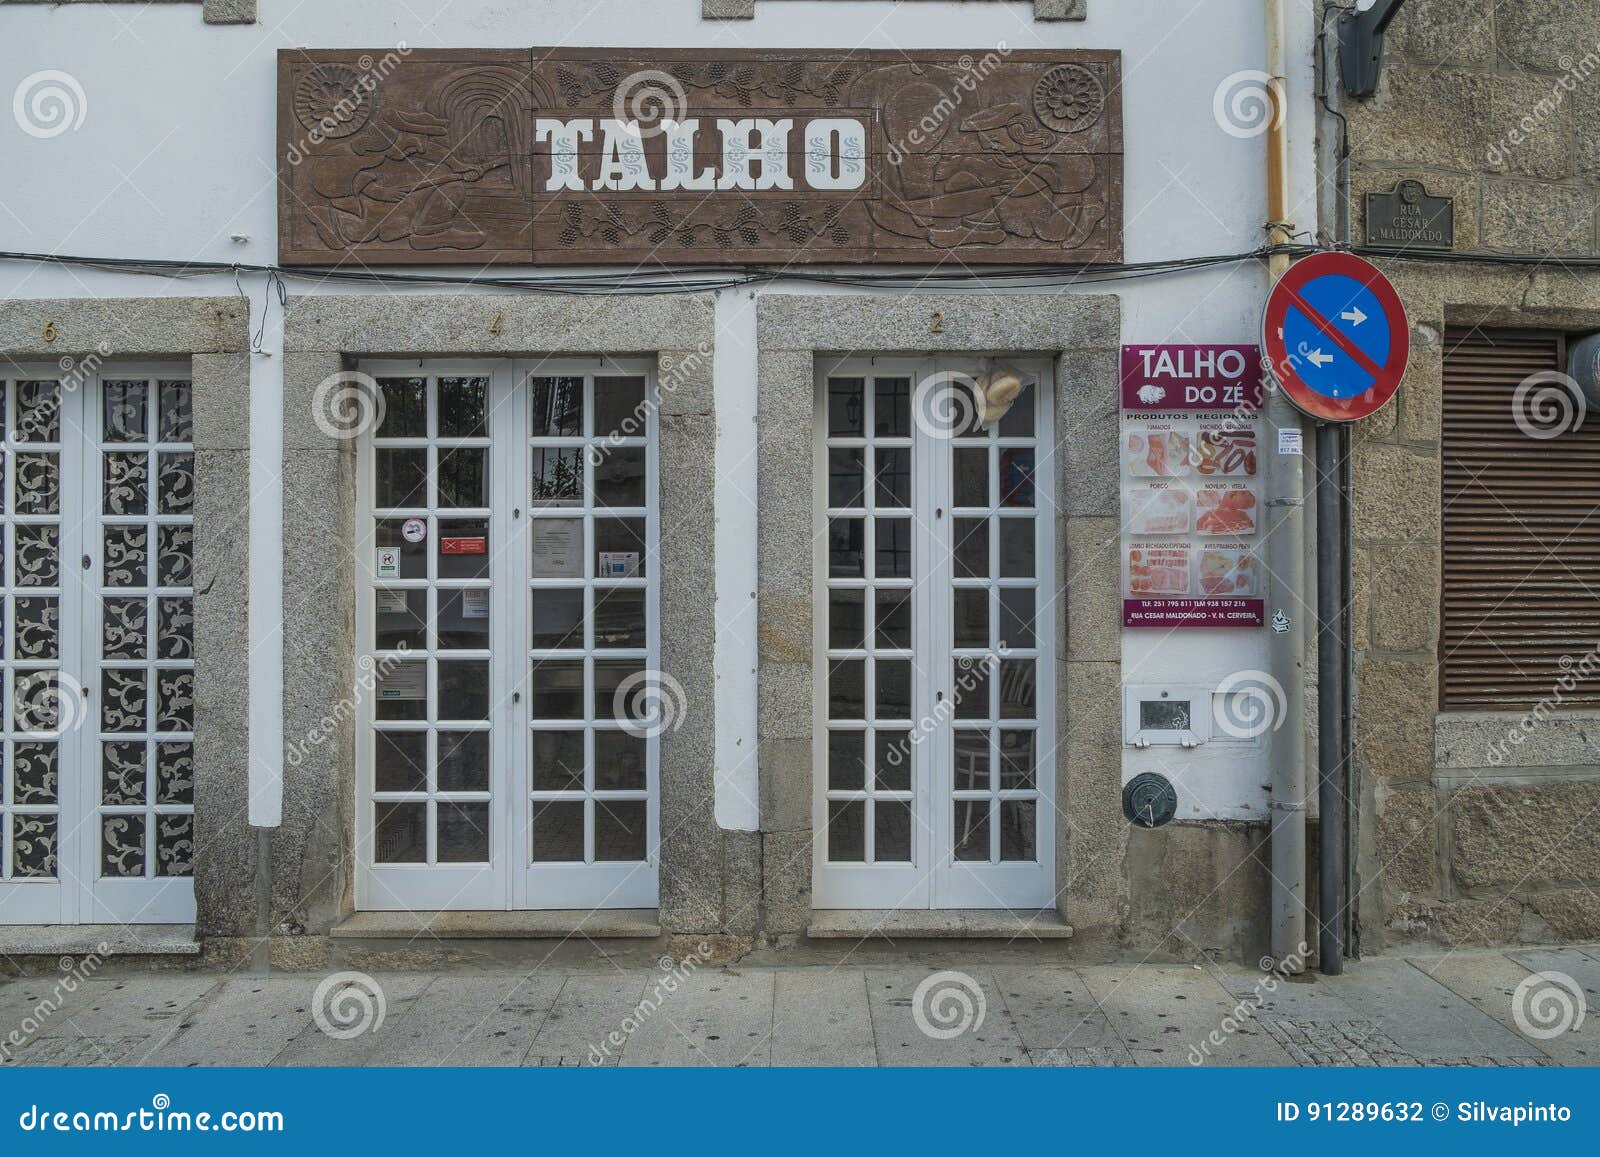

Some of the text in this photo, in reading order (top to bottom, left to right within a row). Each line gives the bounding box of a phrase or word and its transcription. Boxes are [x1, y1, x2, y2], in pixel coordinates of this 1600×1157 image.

[535, 118, 865, 191] TALHO
[1400, 204, 1421, 216] RUA
[1380, 228, 1442, 241] MALDONADO
[44, 319, 57, 341] 6
[489, 311, 502, 336] 4
[930, 309, 945, 333] 2
[1138, 350, 1246, 379] TALHO
[1185, 381, 1244, 403] DO ZÉ
